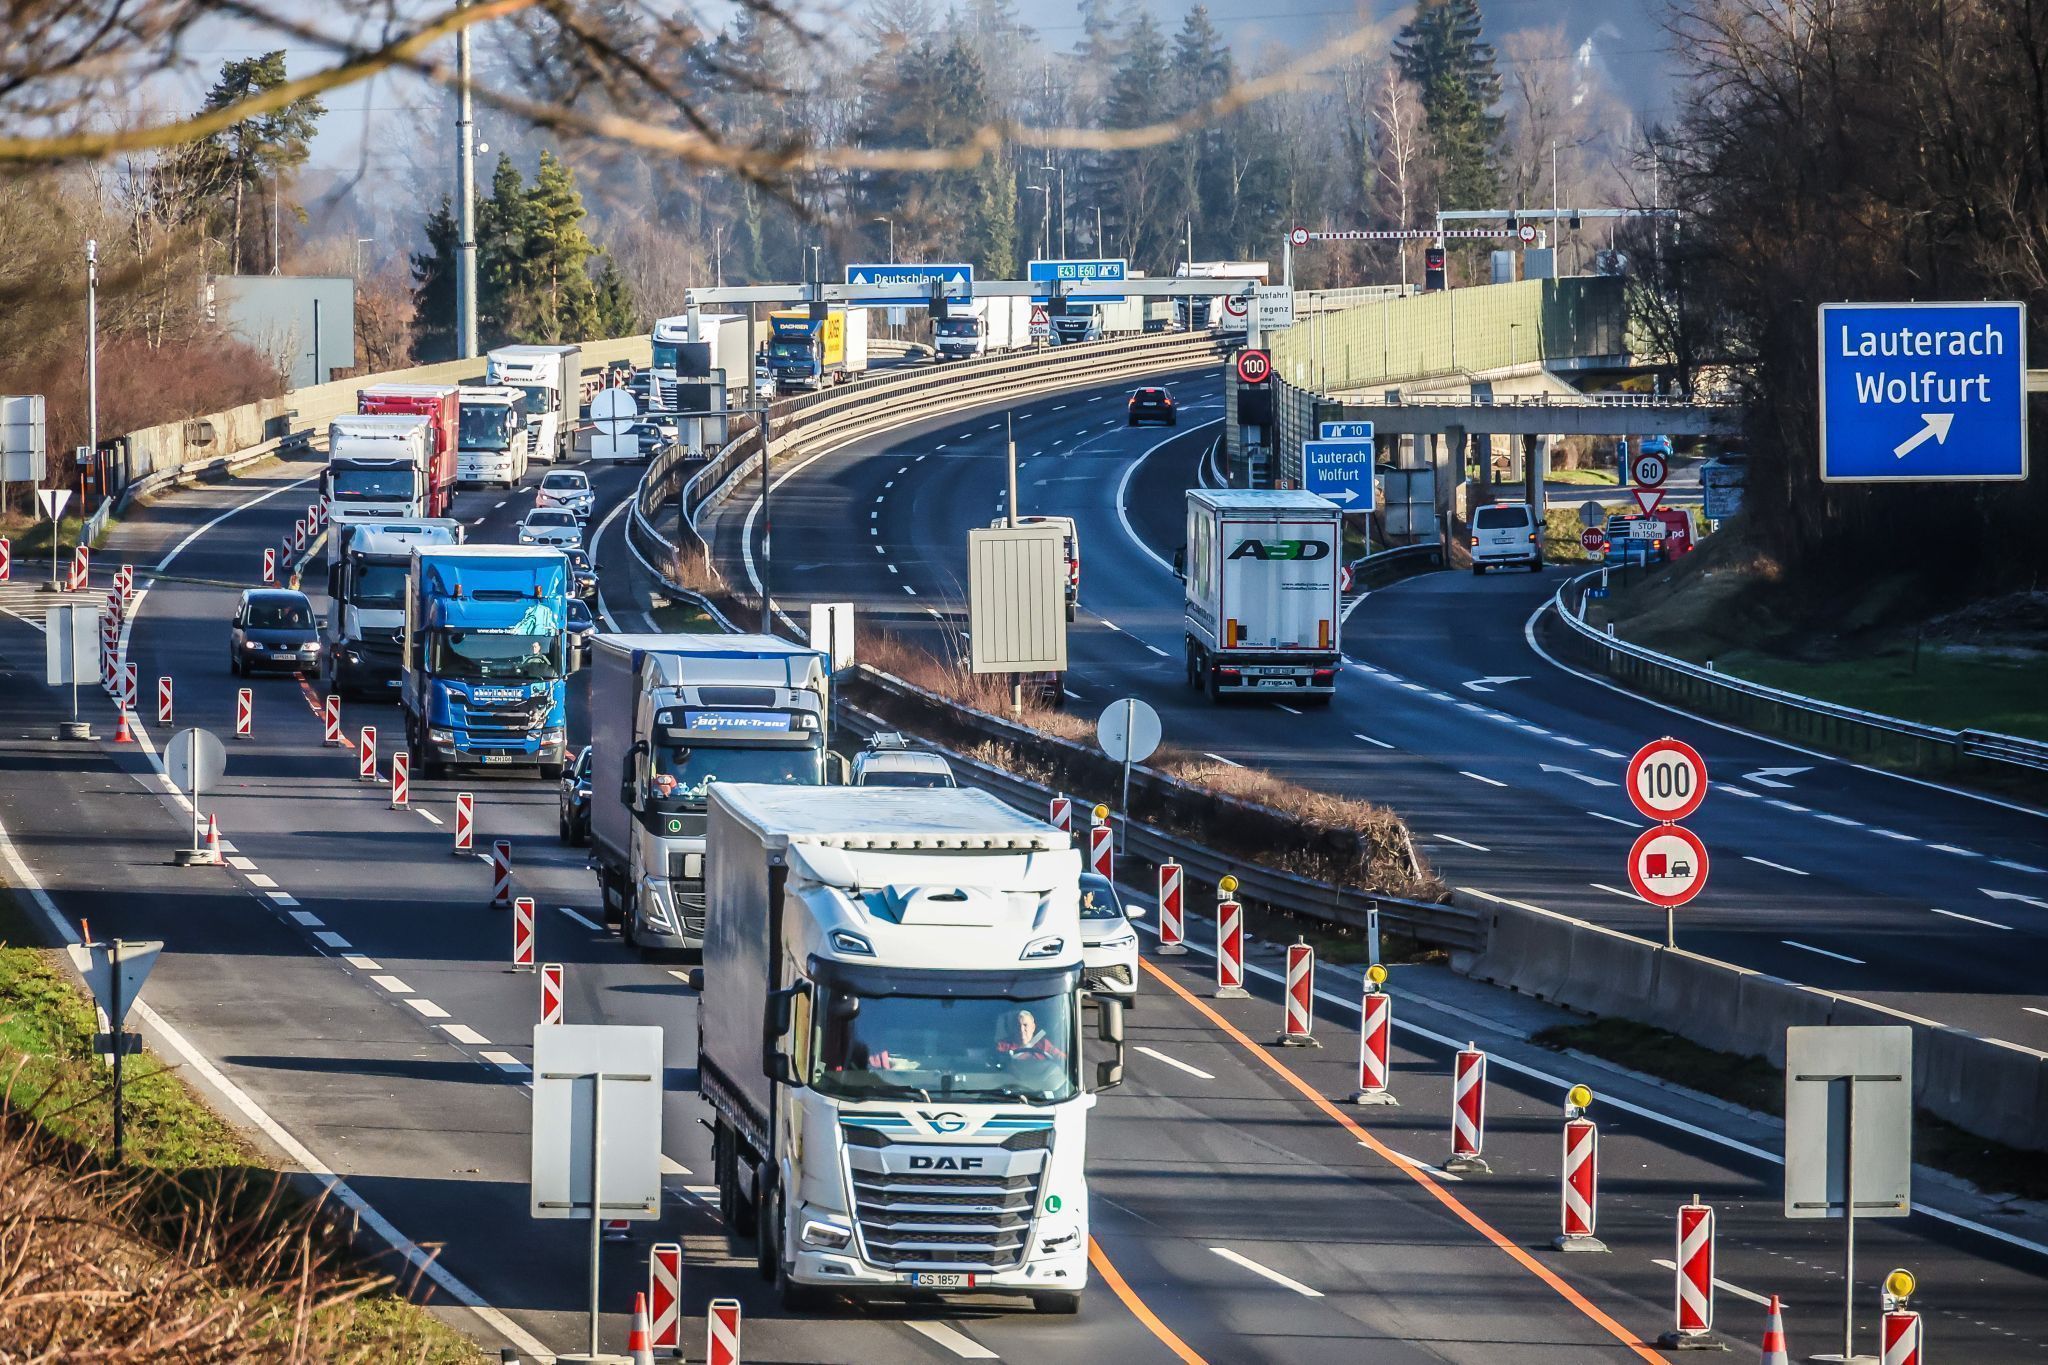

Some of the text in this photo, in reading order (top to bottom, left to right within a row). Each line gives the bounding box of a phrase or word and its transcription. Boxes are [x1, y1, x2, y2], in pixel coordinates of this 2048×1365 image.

[1059, 265, 1119, 277] E43 E60 9
[874, 273, 944, 284] Deutschland
[1260, 291, 1289, 299] usfahrt
[1260, 306, 1289, 315] regenz
[780, 323, 809, 331] DACHSER
[1841, 323, 2004, 357] Lauterach
[1243, 359, 1265, 374] 100
[1855, 371, 1991, 404] Wolfurt
[1350, 425, 1363, 436] 10
[1311, 450, 1366, 464] Lauterach
[1318, 468, 1360, 481] Wolfurt
[1641, 462, 1658, 479] 60
[1638, 522, 1658, 530] STOP
[1583, 533, 1603, 544] STOP
[1642, 530, 1663, 539] 150m
[1643, 762, 1691, 799] 100
[909, 1155, 984, 1170] DAF
[919, 1274, 960, 1286] CS 1857
